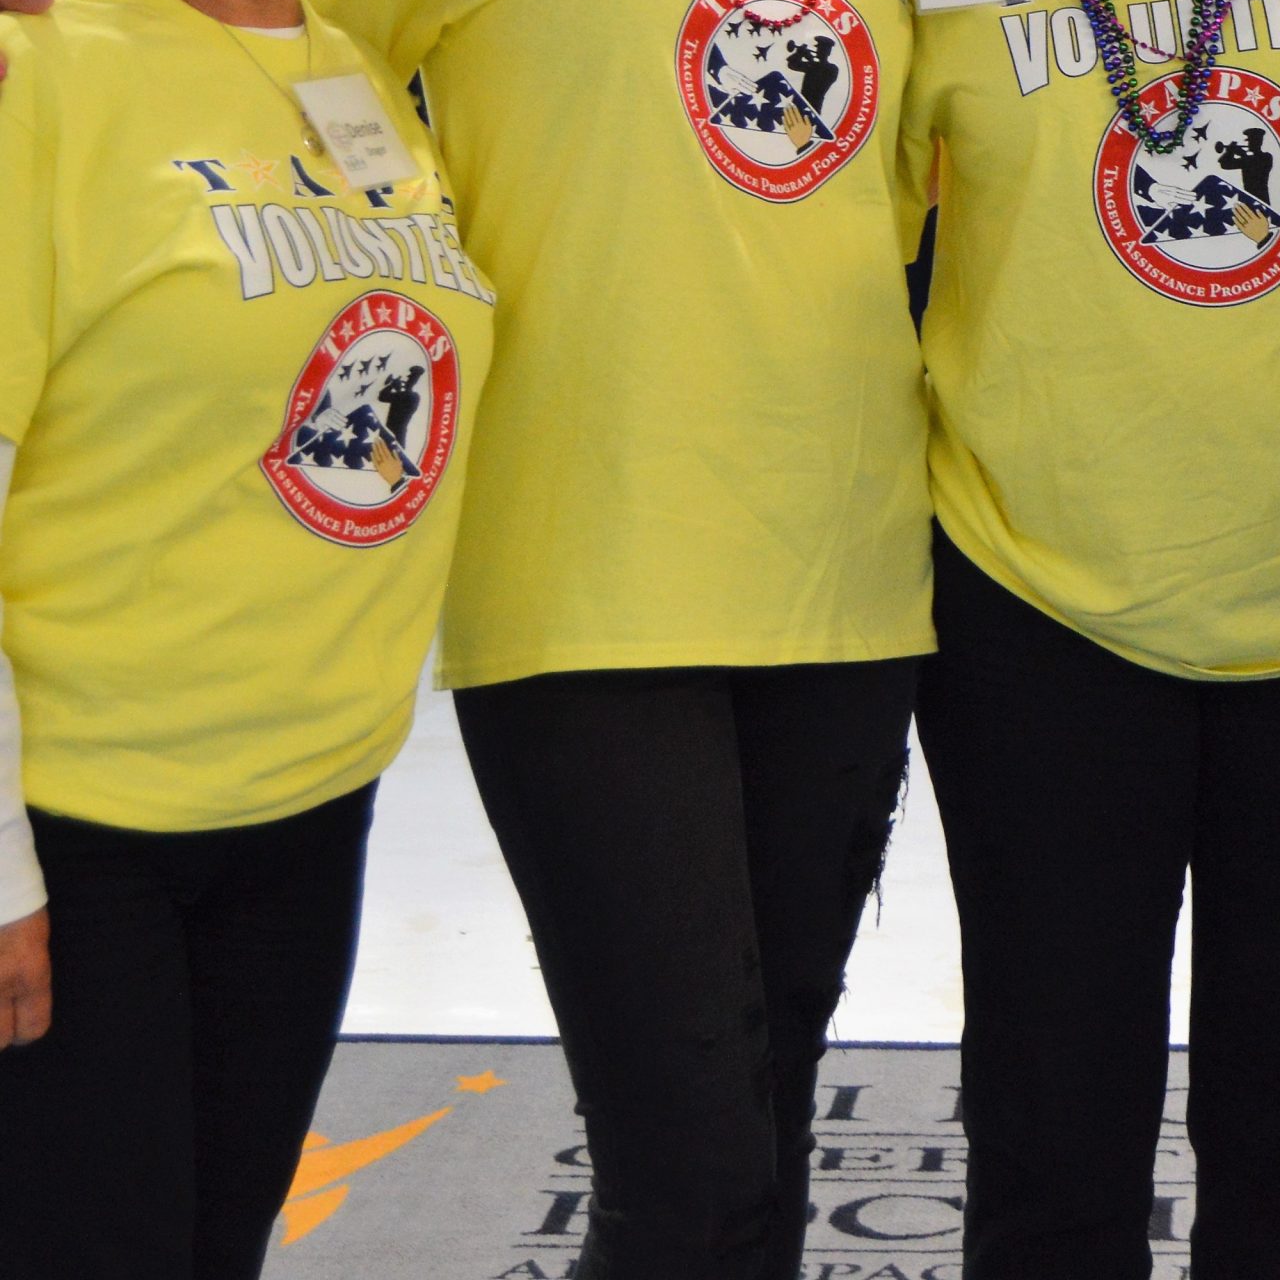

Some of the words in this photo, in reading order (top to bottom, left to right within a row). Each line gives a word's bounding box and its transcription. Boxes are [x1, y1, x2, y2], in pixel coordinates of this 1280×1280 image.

[682, 39, 700, 113] TRAGEDY
[696, 117, 760, 189] ASSISTANCE
[761, 173, 813, 194] PROGRAM
[811, 153, 841, 177] FOR
[836, 64, 873, 153] SURVIVORS
[1103, 166, 1126, 238] TRAGEDY
[1122, 240, 1206, 297] ASSISTANCE
[1209, 262, 1280, 298] PROGRAM
[269, 458, 345, 533] ASSISTANCE
[343, 512, 406, 538] PROGRAM
[422, 391, 454, 489] SURVIVORS
